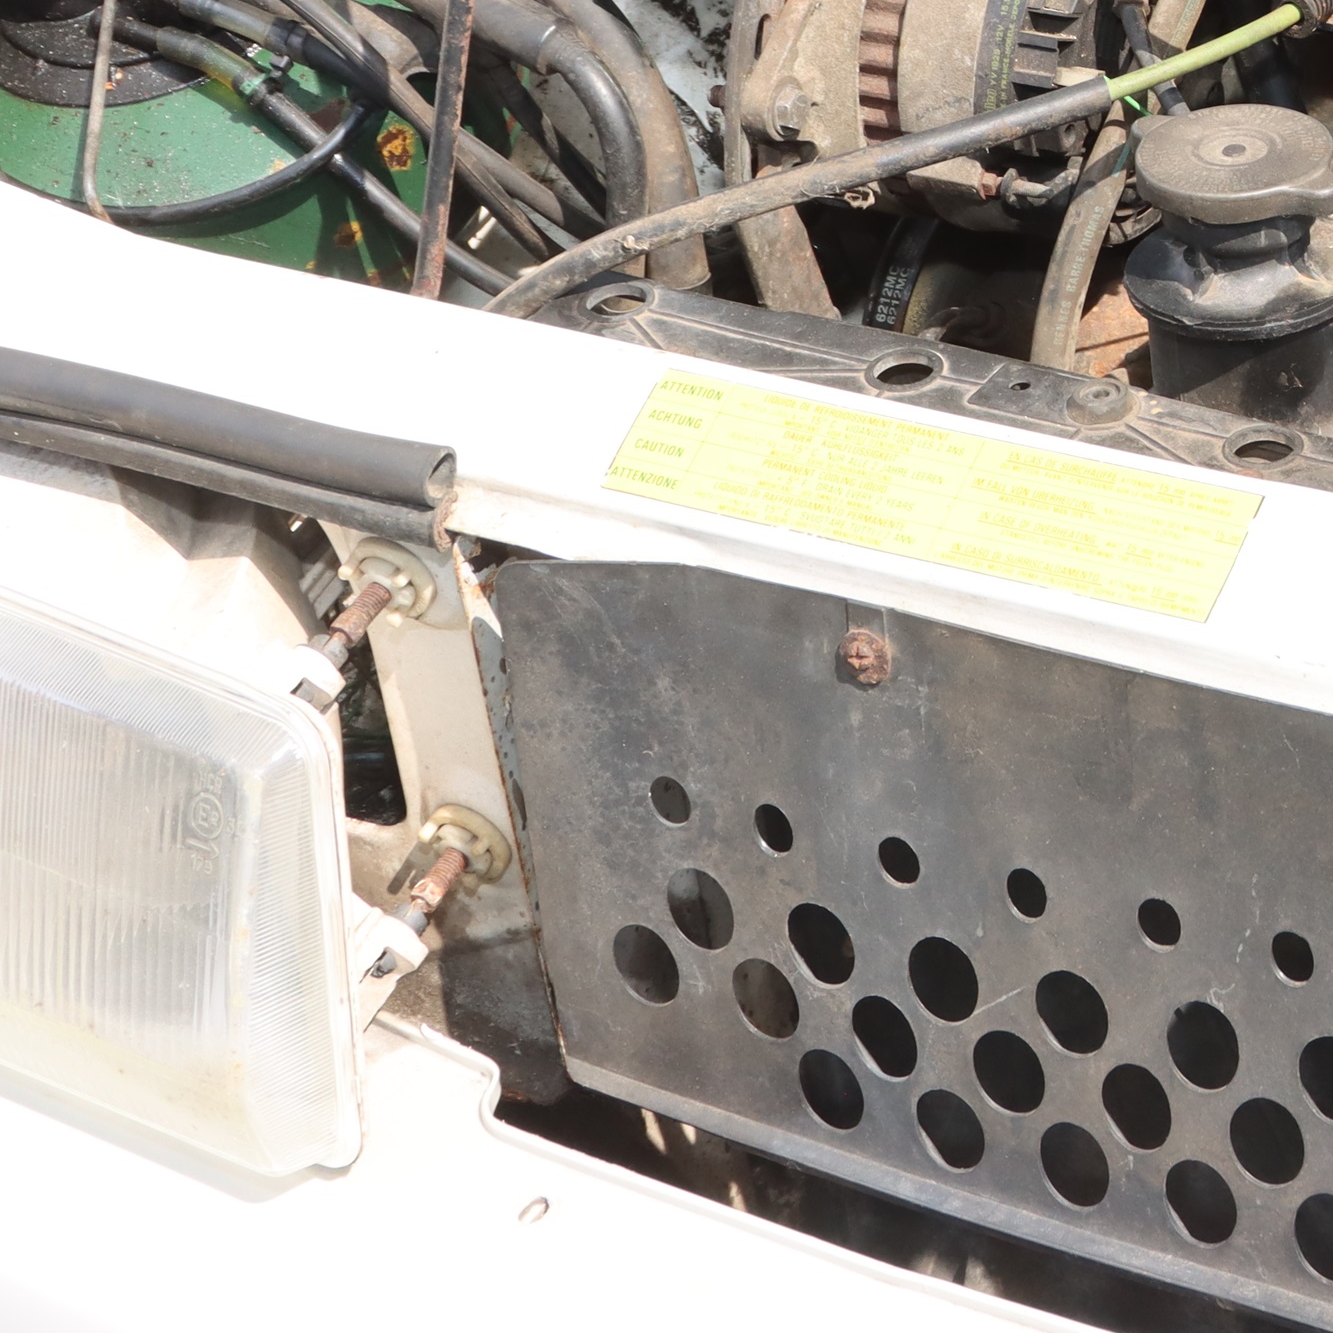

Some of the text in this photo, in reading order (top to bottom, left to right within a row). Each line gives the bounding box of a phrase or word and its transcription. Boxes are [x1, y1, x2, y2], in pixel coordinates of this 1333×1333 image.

[995, 24, 1005, 45] 12V
[659, 377, 726, 402] ATTENTION
[646, 406, 706, 430] ACHTUNG
[894, 422, 951, 441] PERMANENT
[631, 435, 689, 459] CAUTION
[608, 463, 682, 490] ATTENZIONE
